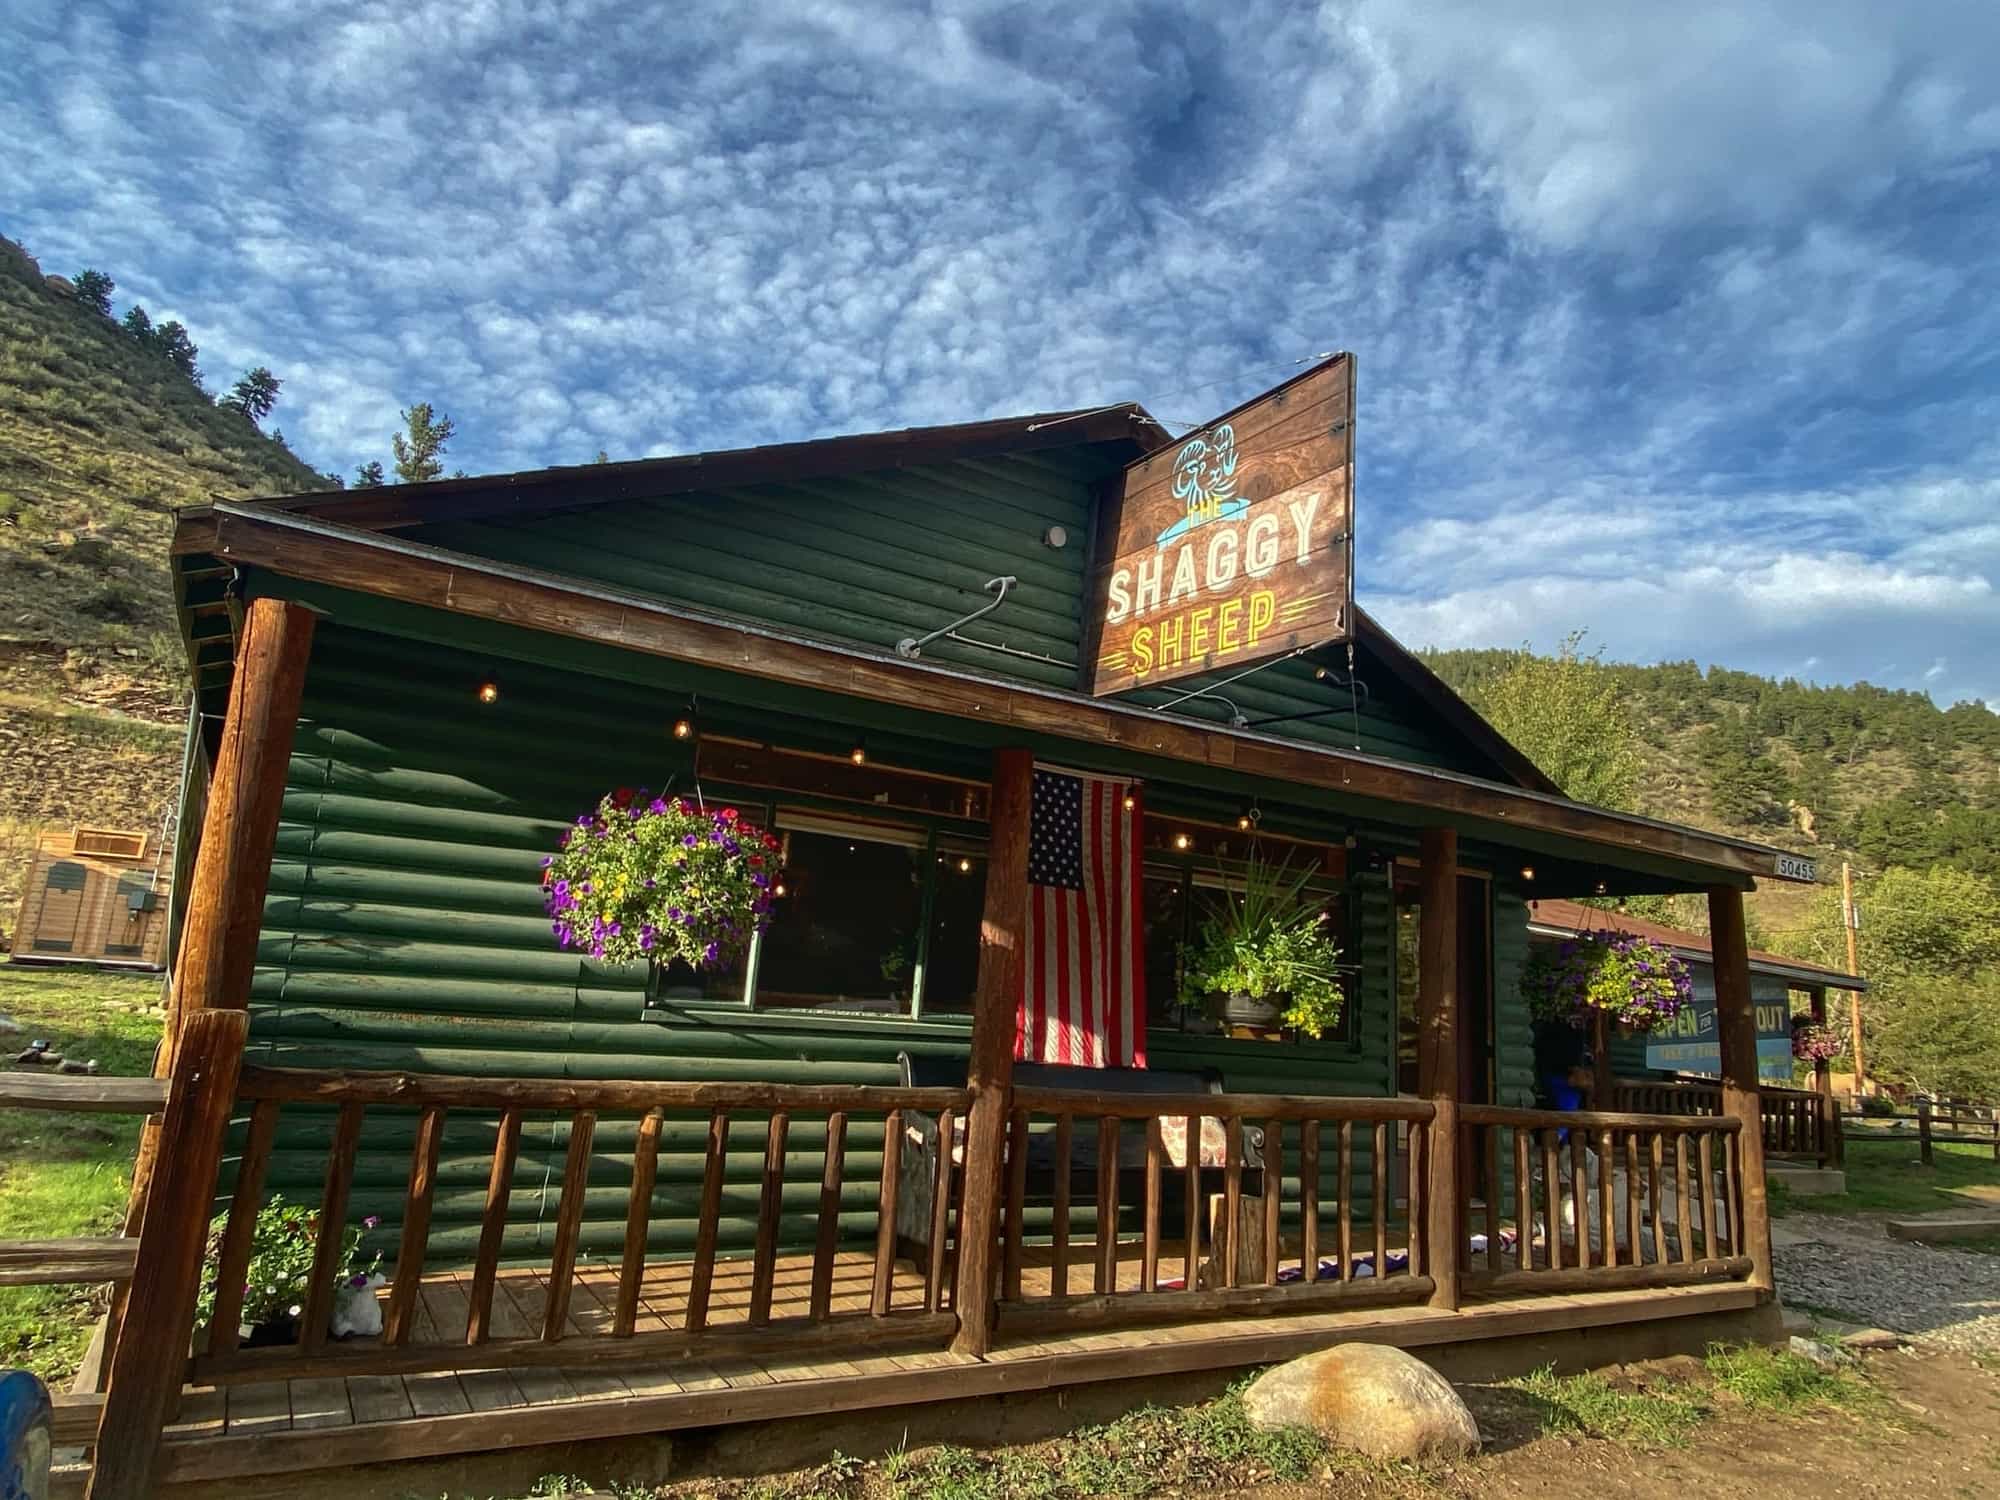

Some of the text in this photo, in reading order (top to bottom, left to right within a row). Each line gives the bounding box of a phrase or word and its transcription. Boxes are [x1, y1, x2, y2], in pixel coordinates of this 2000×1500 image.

[1106, 491, 1321, 625] SHAGGY
[1131, 590, 1276, 678] SHEEP
[1780, 859, 1815, 880] 50455
